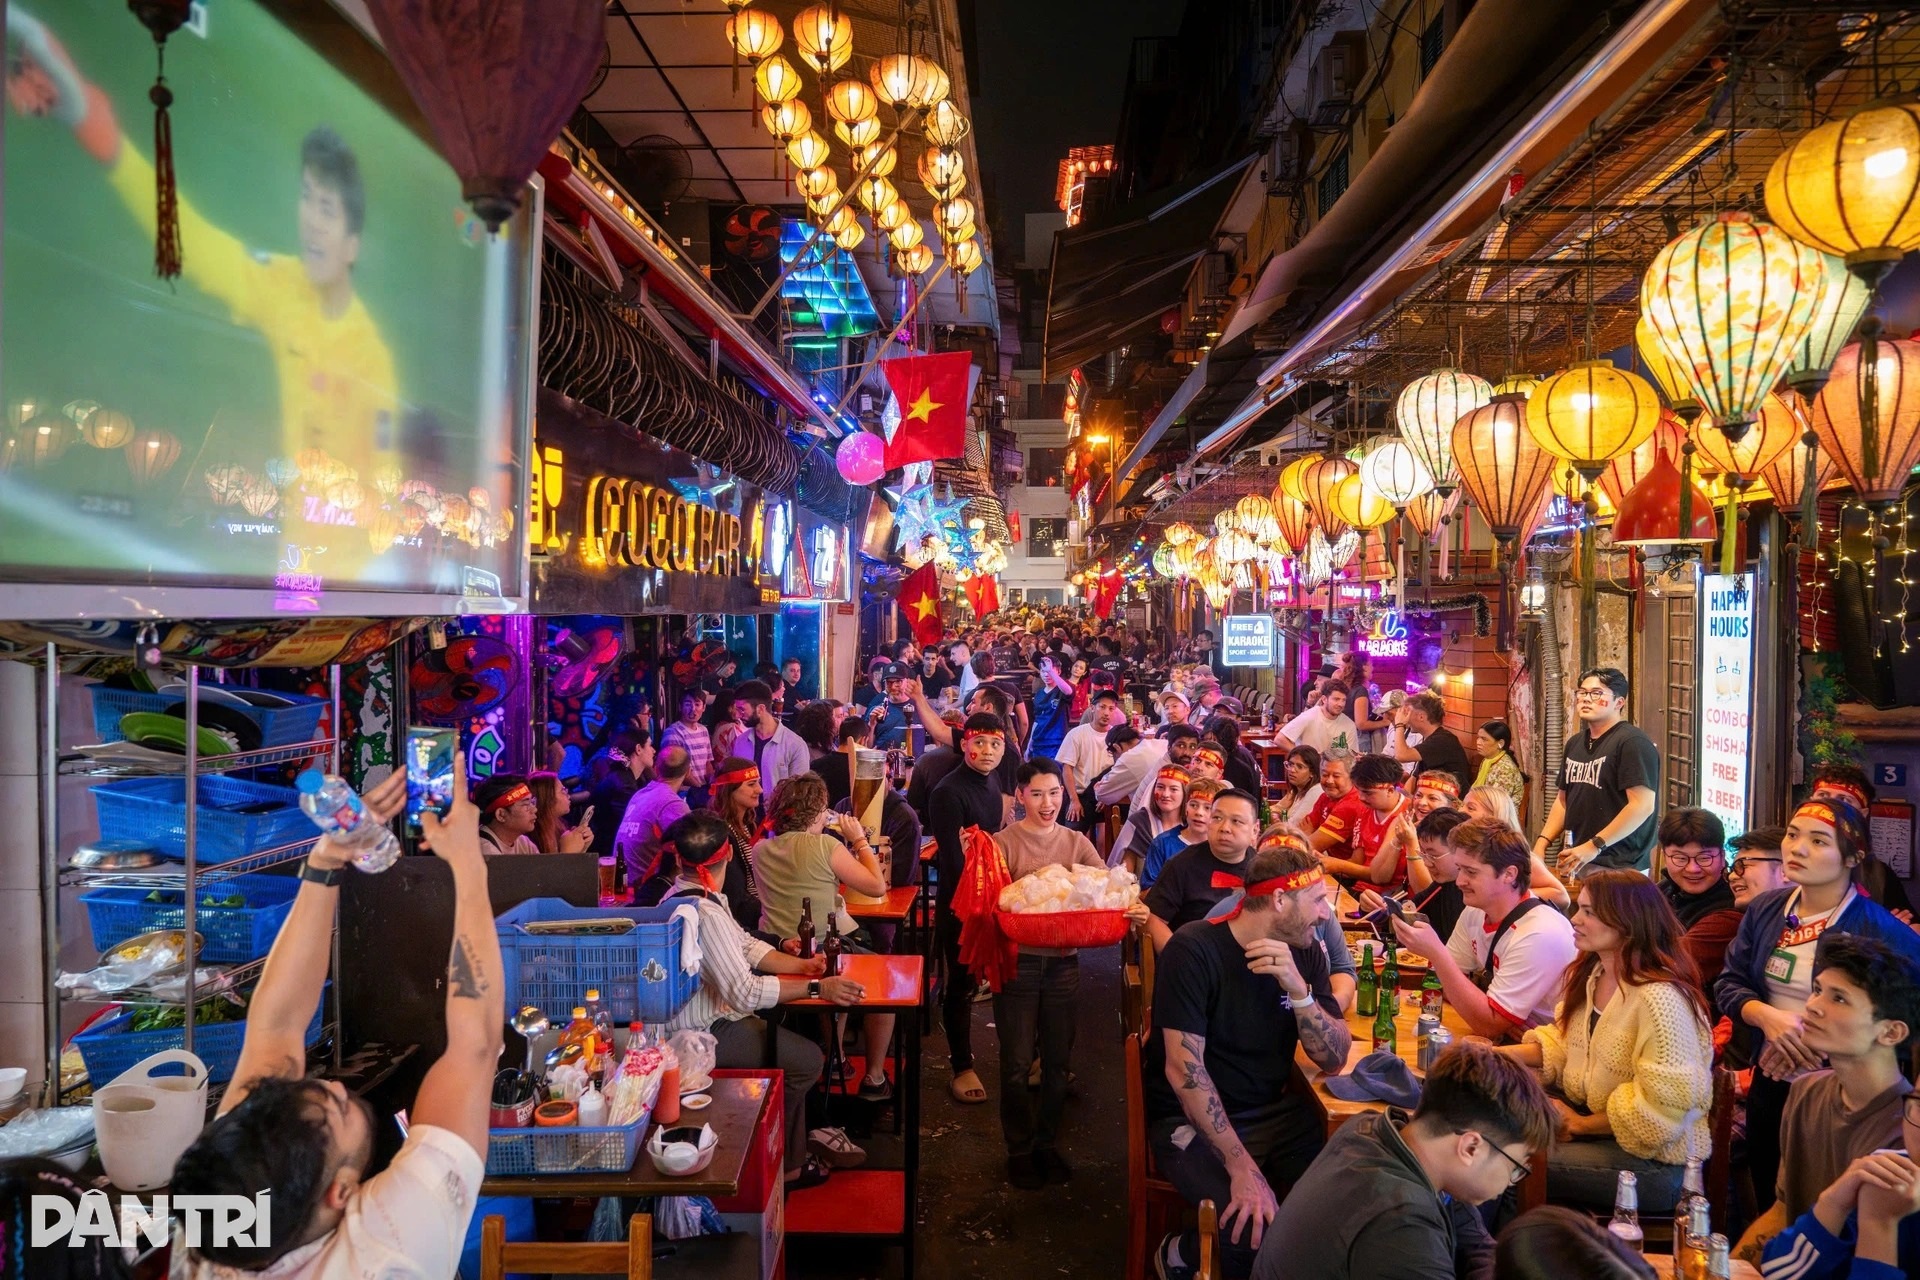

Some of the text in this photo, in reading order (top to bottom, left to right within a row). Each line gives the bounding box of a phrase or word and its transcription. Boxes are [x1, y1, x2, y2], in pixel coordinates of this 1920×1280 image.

[595, 476, 689, 572] COCO
[696, 504, 742, 577] BAR
[1711, 590, 1749, 611] HAPPY
[1231, 623, 1254, 631] FREE
[1710, 616, 1748, 638] HOURS
[1228, 635, 1269, 646] KARAOKE
[1358, 639, 1408, 657] KARAOKE
[1706, 708, 1748, 729] COMBO
[1705, 734, 1747, 758] SHISHA
[1712, 762, 1738, 782] FREE
[1884, 765, 1898, 783] 3
[1707, 788, 1742, 812] 2 BEER
